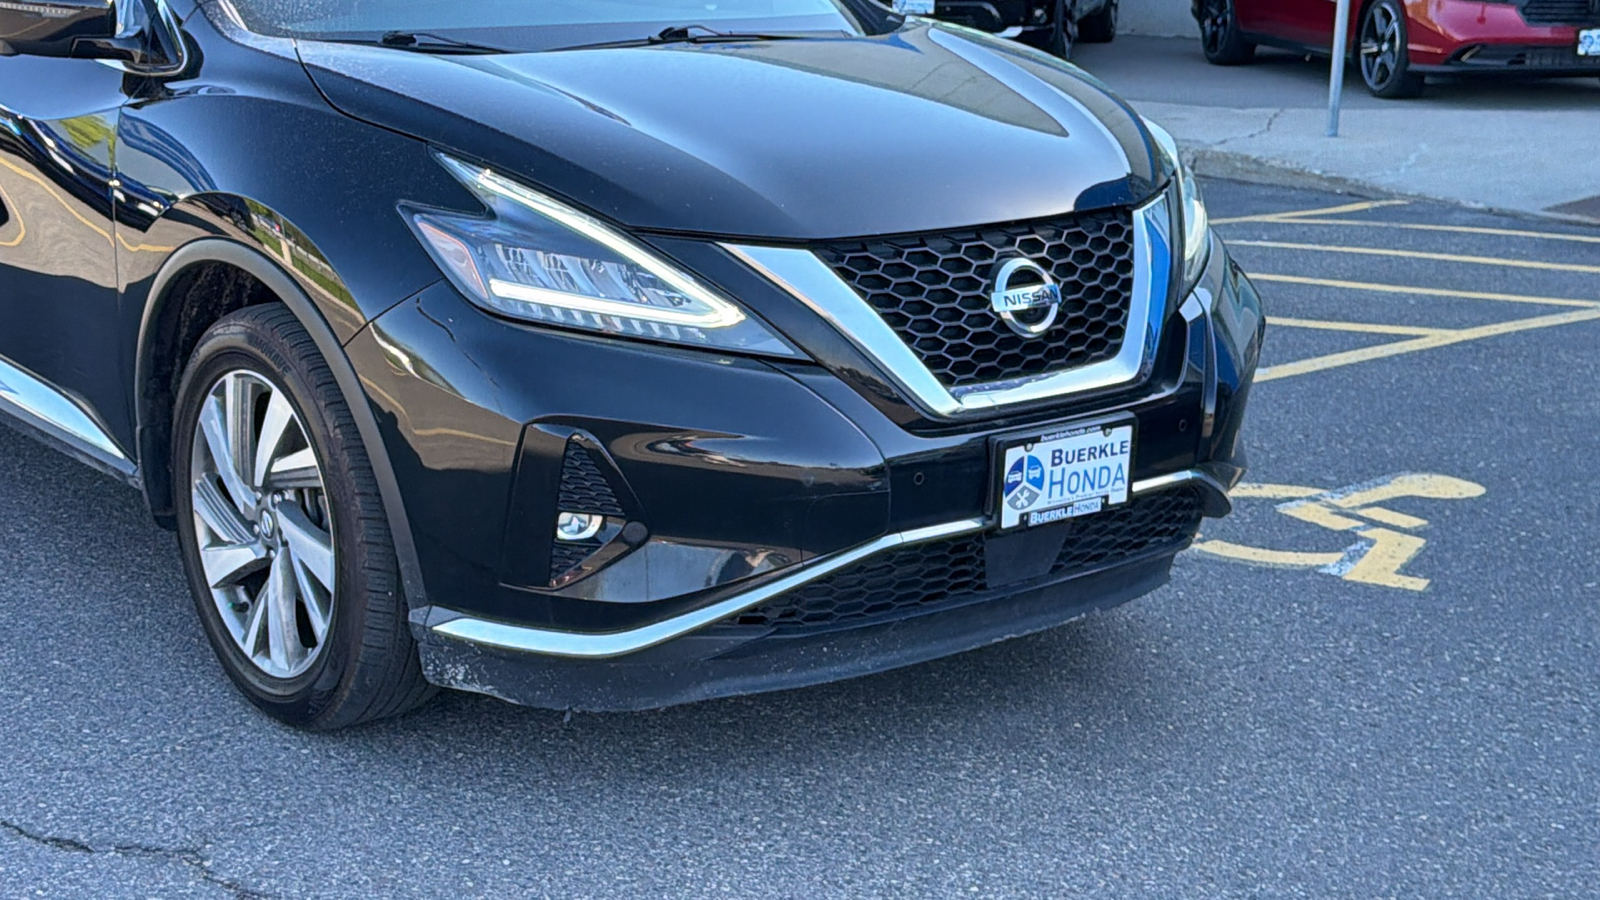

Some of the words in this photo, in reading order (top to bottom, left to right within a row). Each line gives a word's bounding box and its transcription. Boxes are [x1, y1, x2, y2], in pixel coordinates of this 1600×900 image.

[1004, 288, 1058, 307] NISSAN
[1051, 440, 1129, 467] BUERKLE
[1048, 462, 1125, 499] HONDA
[1030, 505, 1074, 524] BUERKLE
[1074, 500, 1100, 513] HONDA
